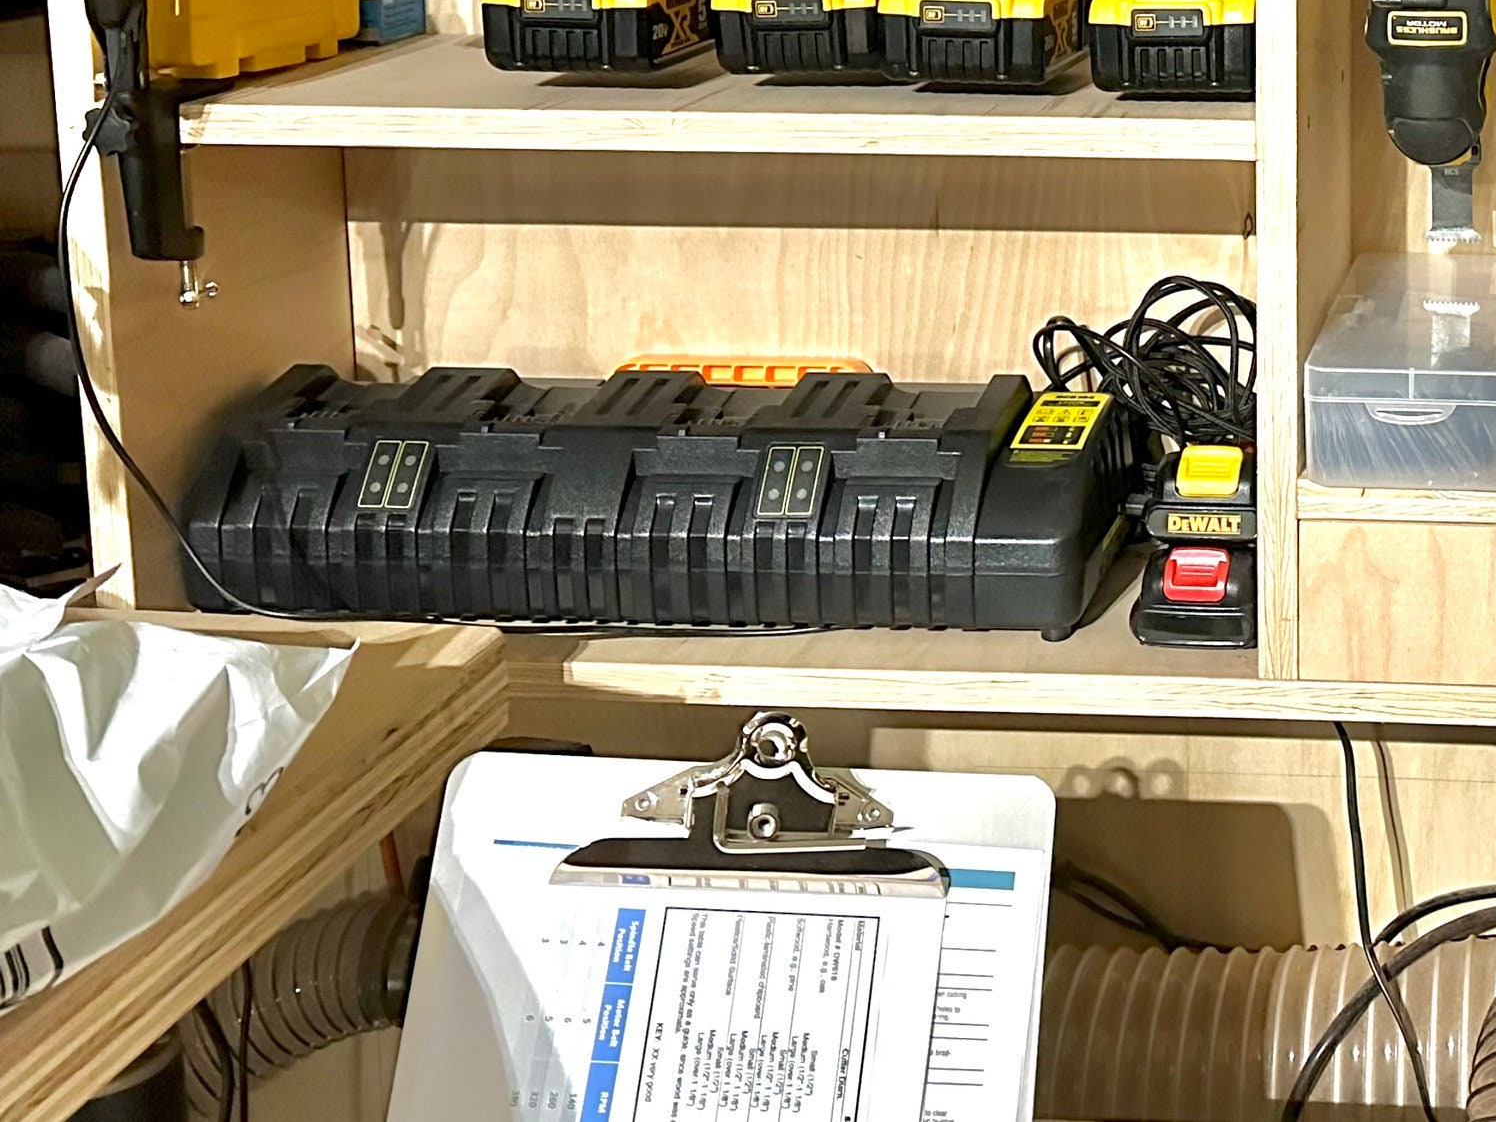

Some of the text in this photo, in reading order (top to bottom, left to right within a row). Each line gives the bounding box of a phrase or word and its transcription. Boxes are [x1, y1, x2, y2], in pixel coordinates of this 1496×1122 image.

[1395, 26, 1458, 34] BRUSHLESS
[1168, 515, 1241, 533] DEWALT
[612, 927, 626, 963] Position
[625, 920, 640, 953] Spindle
[598, 1004, 612, 1041] Position
[615, 998, 625, 1028] Motor
[597, 1091, 609, 1114] RPM
